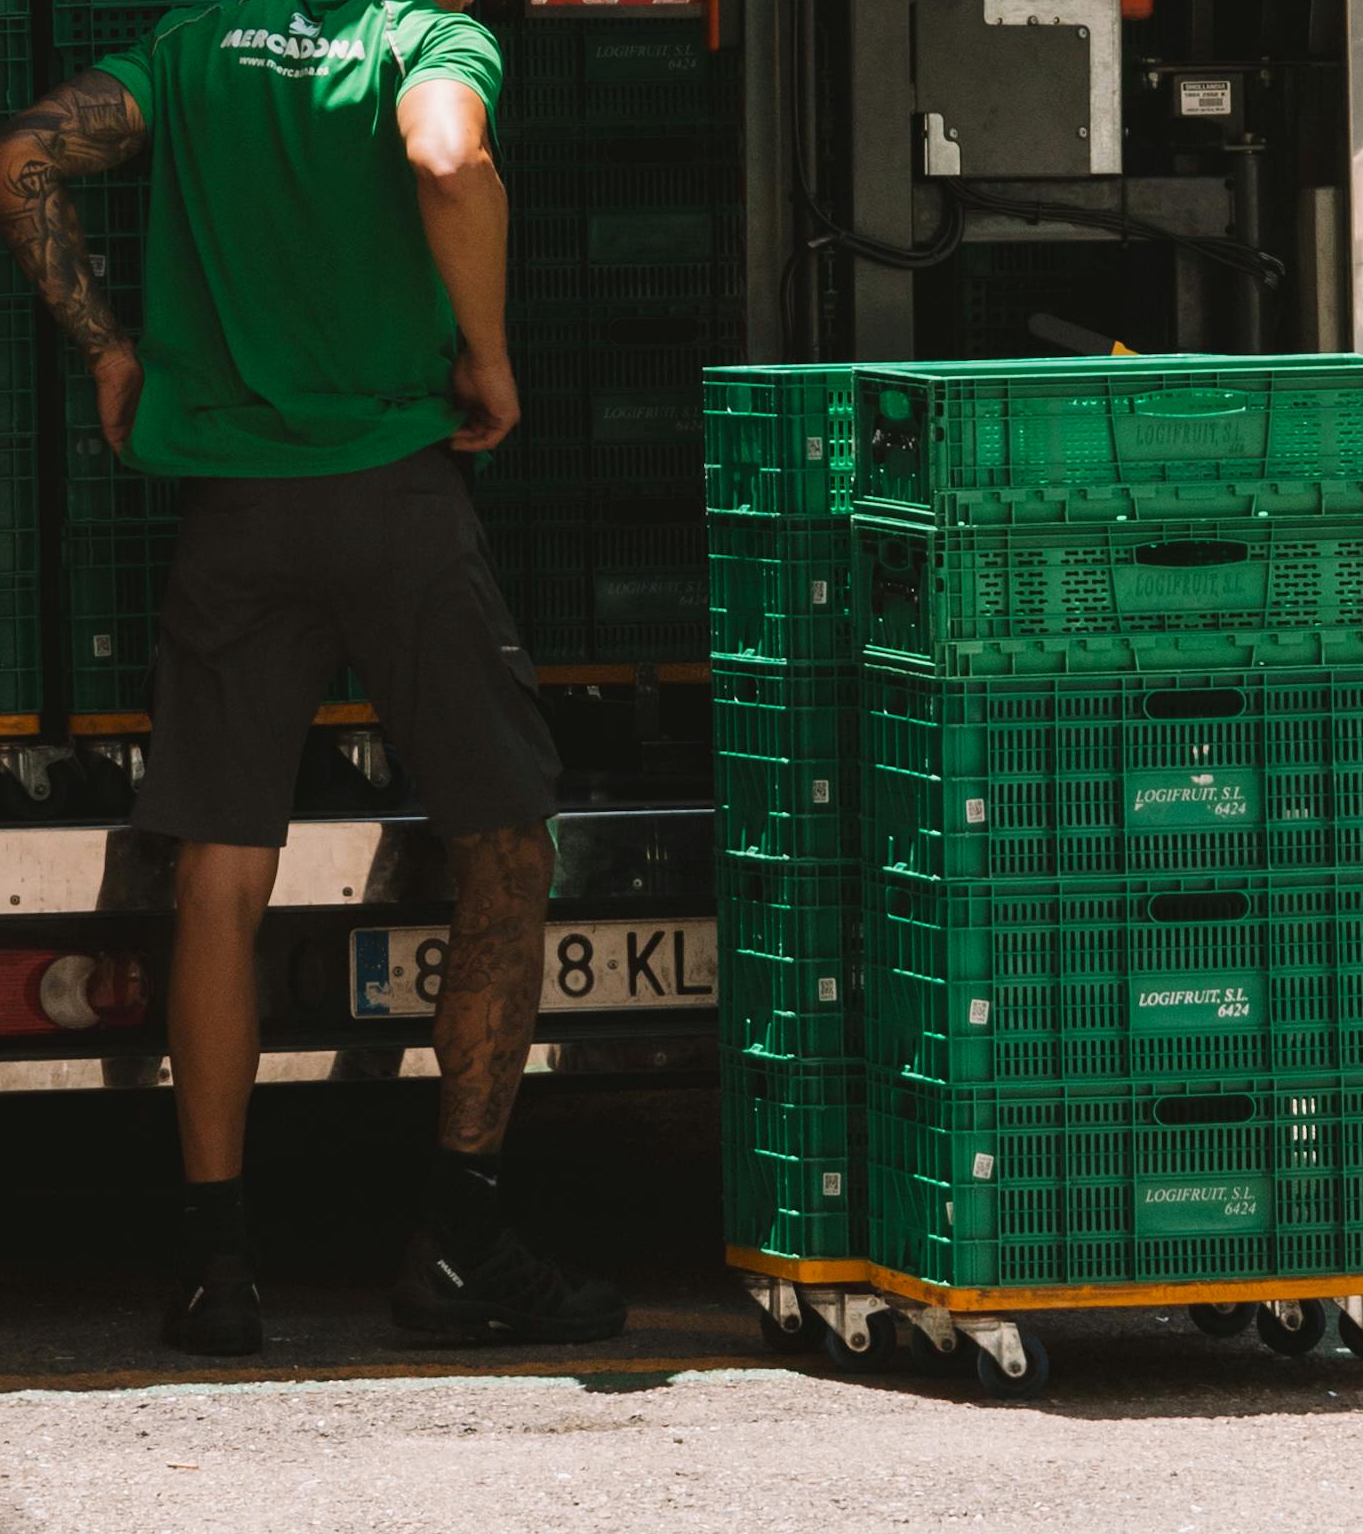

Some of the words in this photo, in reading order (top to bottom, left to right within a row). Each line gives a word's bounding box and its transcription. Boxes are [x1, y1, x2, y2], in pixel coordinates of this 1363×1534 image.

[1215, 802, 1246, 815] 6424
[415, 933, 594, 1004] 88
[627, 930, 712, 997] KL
[1218, 1003, 1250, 1017] 6424
[1224, 1202, 1256, 1215] 6424
